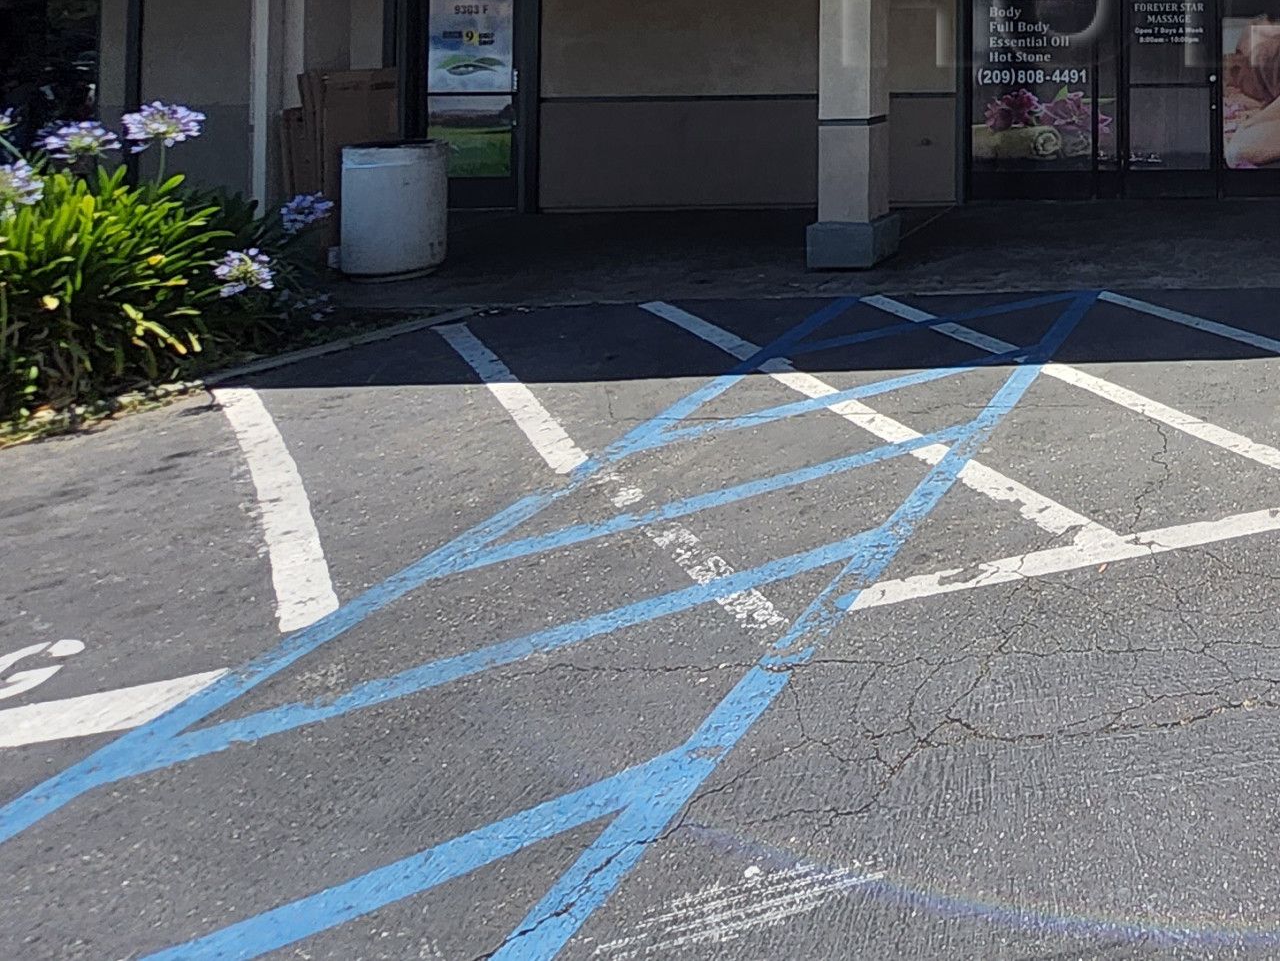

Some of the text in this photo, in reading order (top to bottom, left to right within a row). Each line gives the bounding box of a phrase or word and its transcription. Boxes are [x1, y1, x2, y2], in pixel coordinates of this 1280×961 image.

[989, 6, 1022, 20] Body
[1134, 2, 1204, 12] FOREVER STAR
[1147, 14, 1192, 24] MASSAGE
[989, 21, 1050, 35] Full Body
[989, 36, 1047, 48] Essential
[989, 51, 1052, 63] Hot Stone
